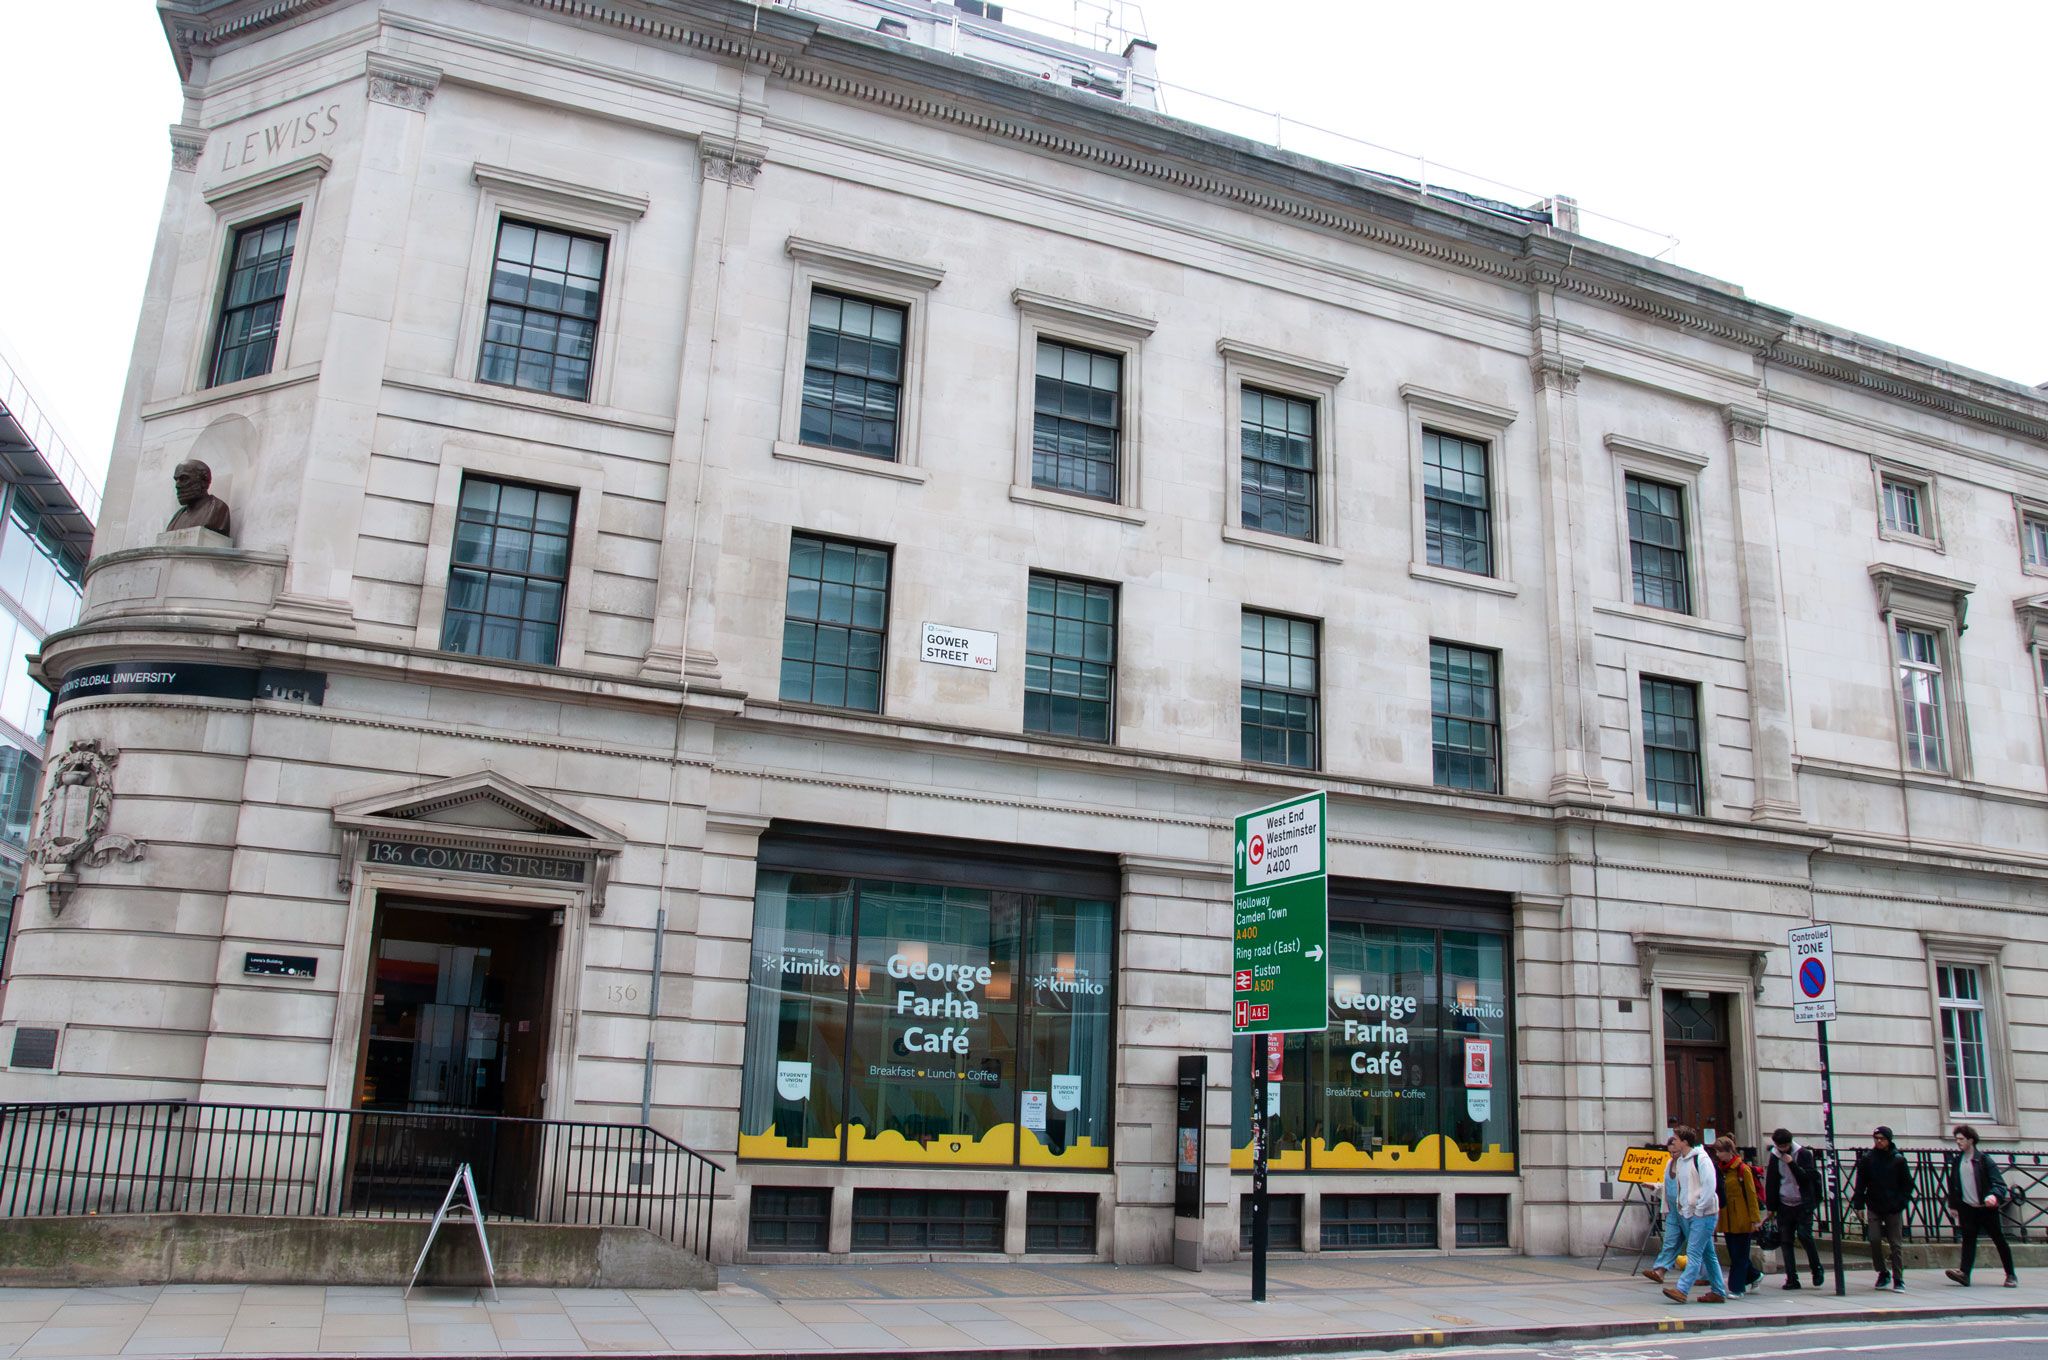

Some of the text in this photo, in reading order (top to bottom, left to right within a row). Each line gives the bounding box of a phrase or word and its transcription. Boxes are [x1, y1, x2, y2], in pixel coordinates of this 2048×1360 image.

[221, 104, 341, 173] LEWIS'S
[927, 634, 969, 649] GOWER
[926, 647, 992, 666] STREET WC1
[80, 674, 111, 687] GLOBAL
[113, 672, 176, 684] UNIVERSITY
[273, 686, 312, 706] UCL
[1266, 809, 1304, 829] West End
[1266, 824, 1317, 844] Westminster
[1266, 844, 1299, 860] Holborn
[371, 843, 583, 880] 136 GOWER STREET
[1266, 858, 1291, 875] A400
[1236, 896, 1271, 911] Holloway
[1236, 908, 1288, 926] Camden Town
[1236, 927, 1258, 940] A400
[1791, 930, 1829, 942] Controlled
[1236, 937, 1301, 960] Ring road (East)
[1797, 942, 1824, 955] ZONE
[780, 955, 841, 977] kimiko
[887, 954, 993, 992] George
[1254, 963, 1281, 977] Euston
[608, 985, 638, 1002] 136
[1050, 976, 1104, 995] kimiko
[1254, 979, 1275, 992] A501
[897, 990, 979, 1020] Farha
[1334, 989, 1417, 1020] George
[1461, 1002, 1504, 1018] kimiko
[903, 1026, 970, 1055] Café
[1344, 1020, 1409, 1044] Farha
[1350, 1051, 1403, 1076] Café
[870, 1065, 998, 1081] Breakfast Lunch Coffee
[1325, 1087, 1426, 1099] Breakfast Lunch Coffee
[1627, 1153, 1663, 1165] Diverted
[1628, 1165, 1654, 1176] traffic
